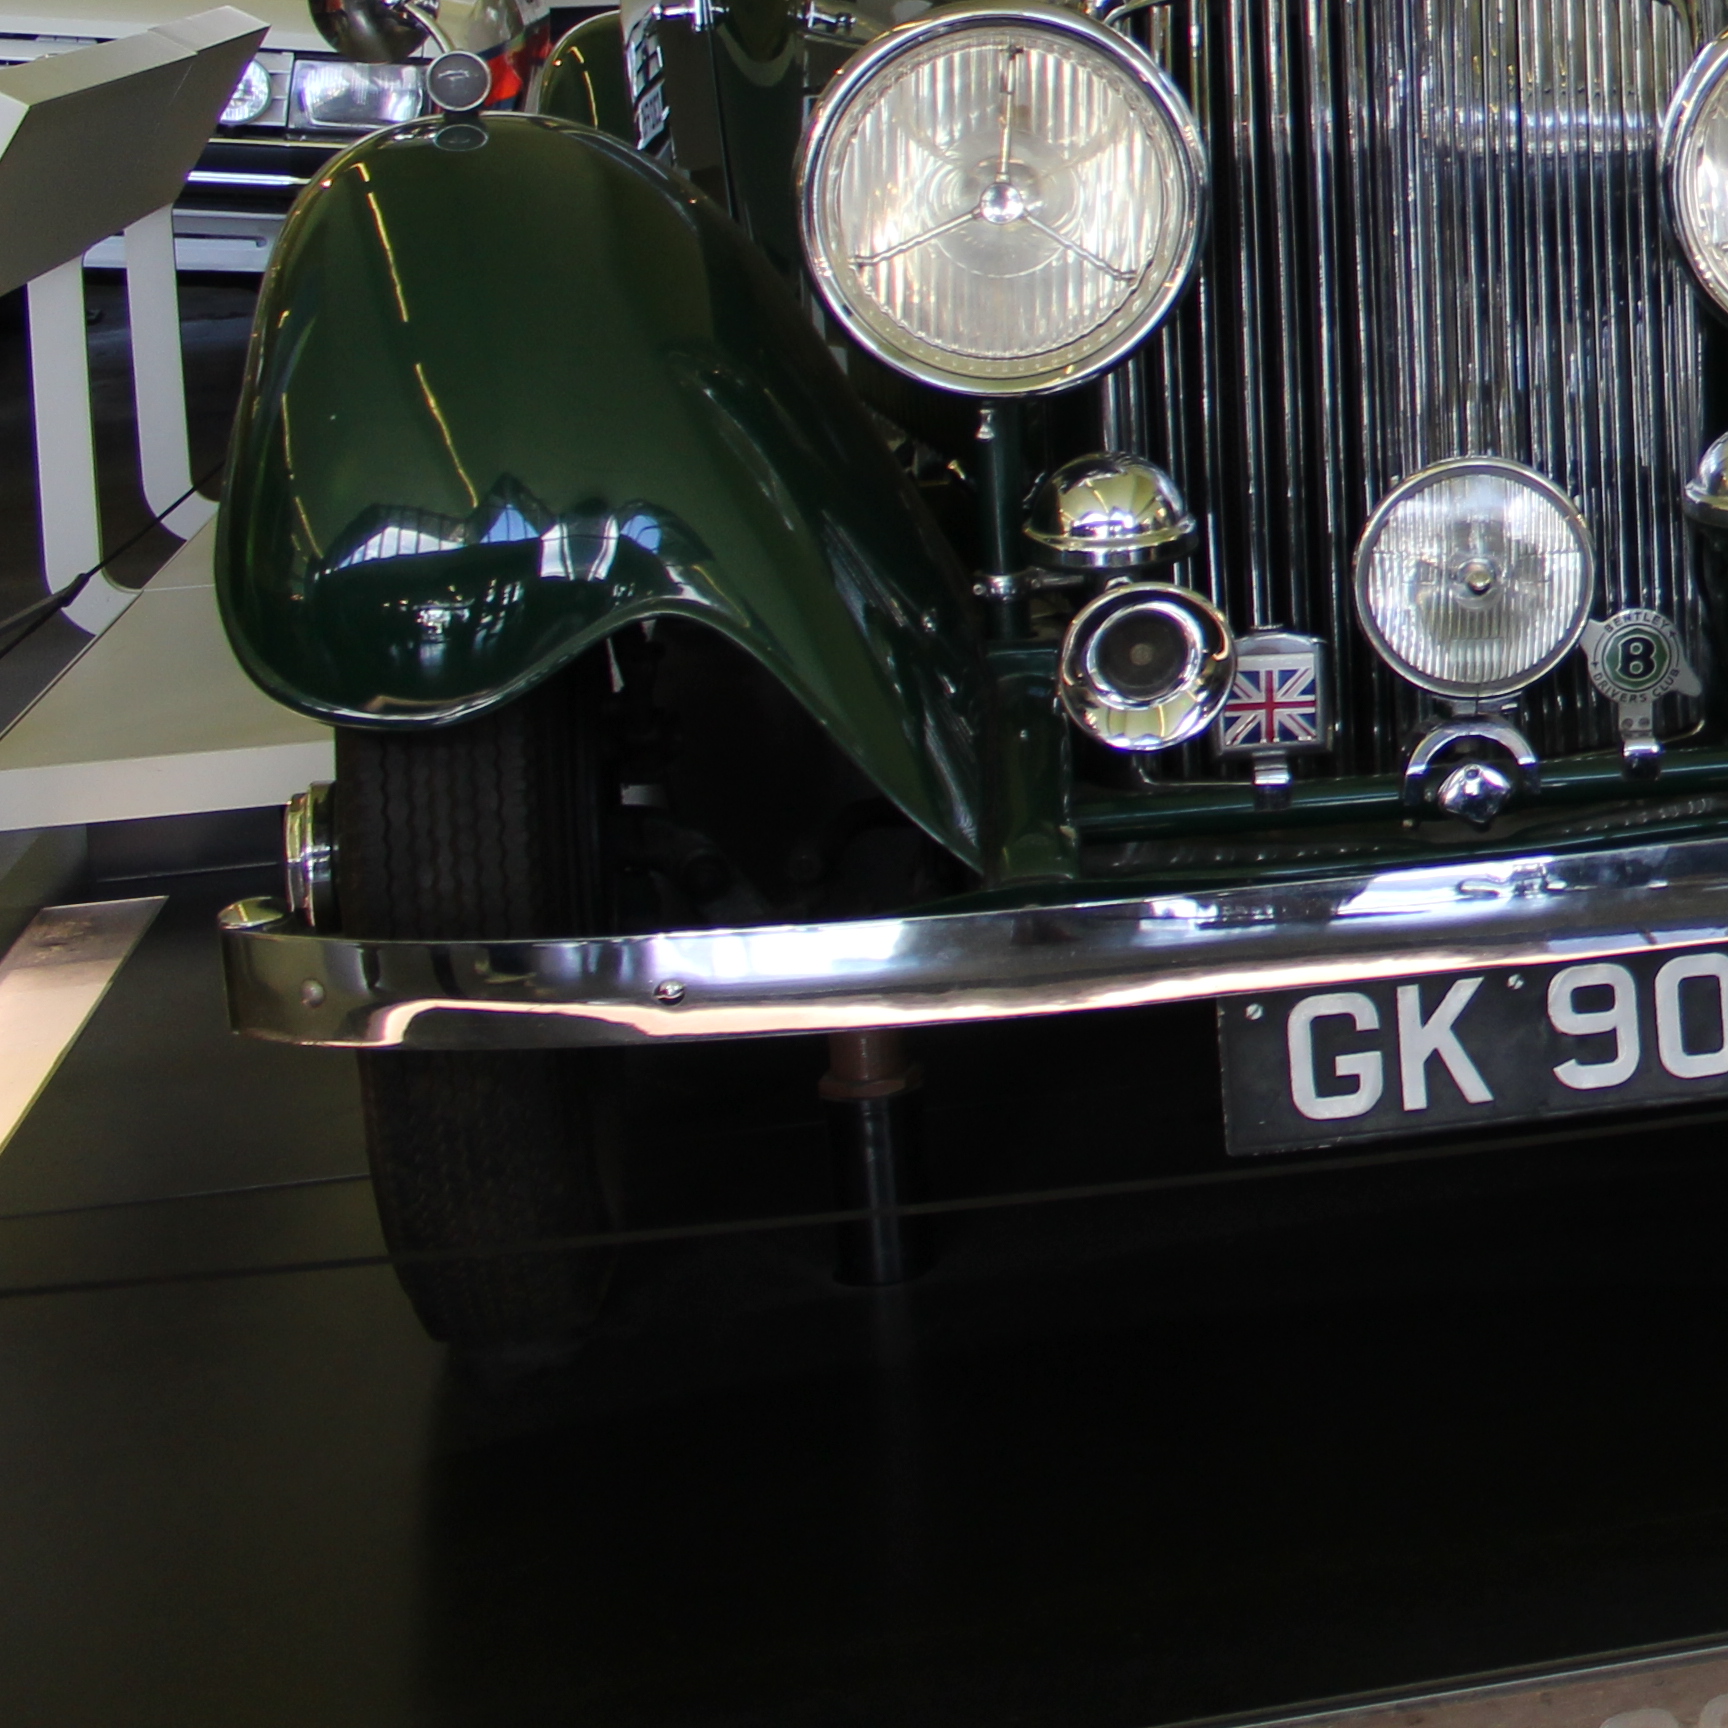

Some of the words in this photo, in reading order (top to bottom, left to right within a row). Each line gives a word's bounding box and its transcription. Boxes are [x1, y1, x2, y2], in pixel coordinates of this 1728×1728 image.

[1604, 612, 1670, 633] BENTLEY
[1616, 635, 1657, 681] B
[1593, 672, 1647, 703] DRIVERS
[1652, 669, 1680, 697] CLUB
[1287, 977, 1494, 1120] GK
